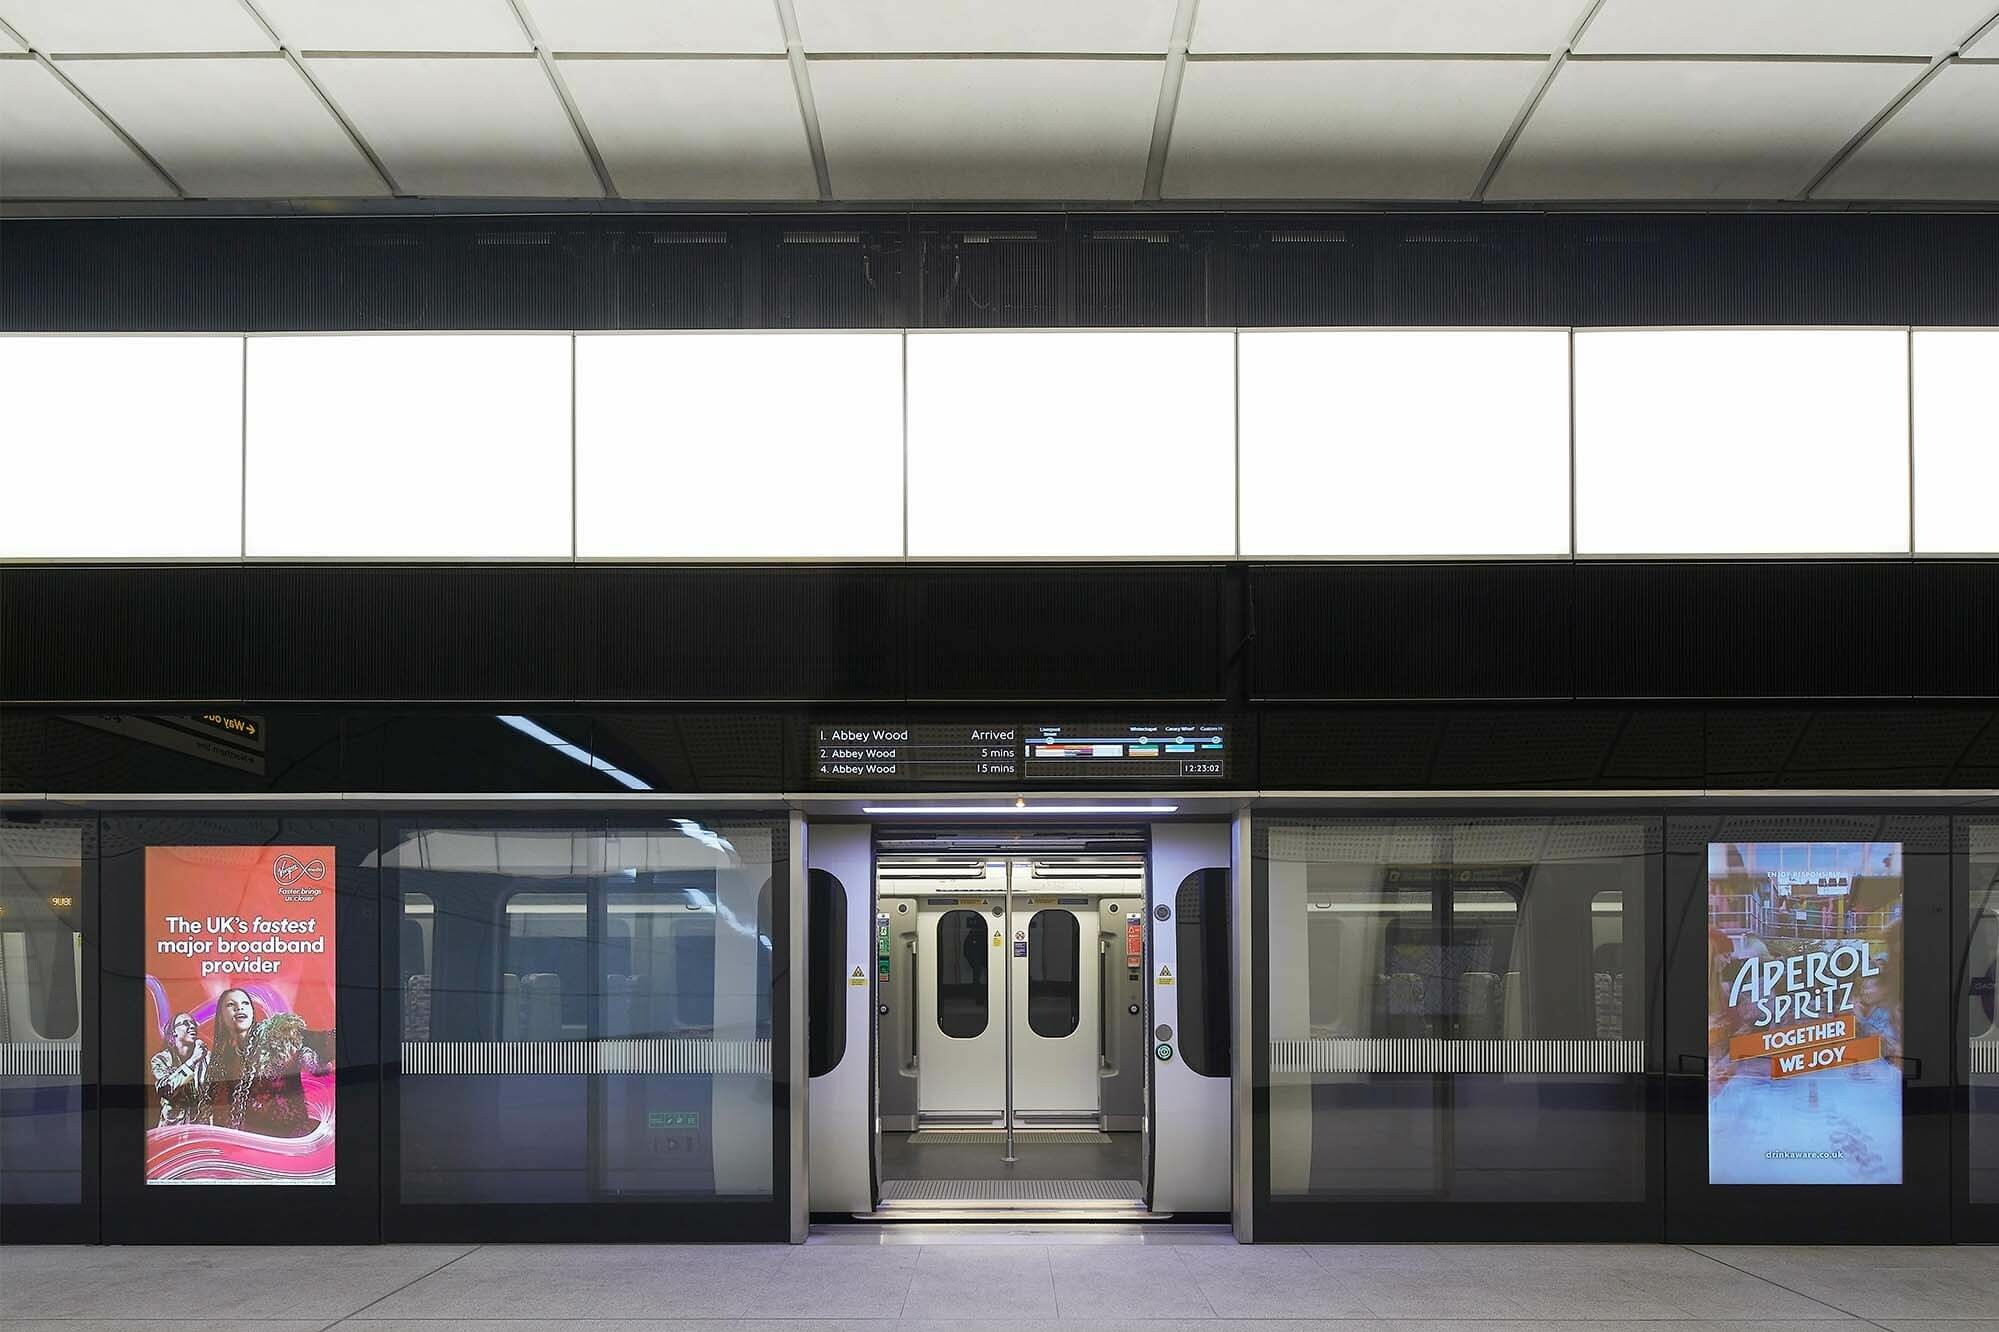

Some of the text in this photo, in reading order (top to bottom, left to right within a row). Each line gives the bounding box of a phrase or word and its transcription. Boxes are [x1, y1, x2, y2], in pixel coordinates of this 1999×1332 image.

[832, 730, 870, 742] Abbey
[872, 730, 908, 740] Wood
[971, 730, 1014, 740] Arrived
[820, 748, 1015, 760] 2. Abbey Wood 5 mins
[820, 764, 1015, 775] 4. Abbey Wood 15 mins
[1184, 764, 1220, 773] 12:23:02
[278, 860, 299, 880] Virgin
[278, 887, 322, 897] Faster brings
[165, 916, 316, 934] The UK's fastest
[157, 936, 325, 957] major broadband
[201, 956, 281, 976] provider
[1728, 942, 1880, 1008] APEROL
[1762, 1020, 1846, 1050] TOGETHER
[1778, 1046, 1846, 1073] WE JOY
[1766, 1150, 1844, 1159] drinkaware.co.uk
